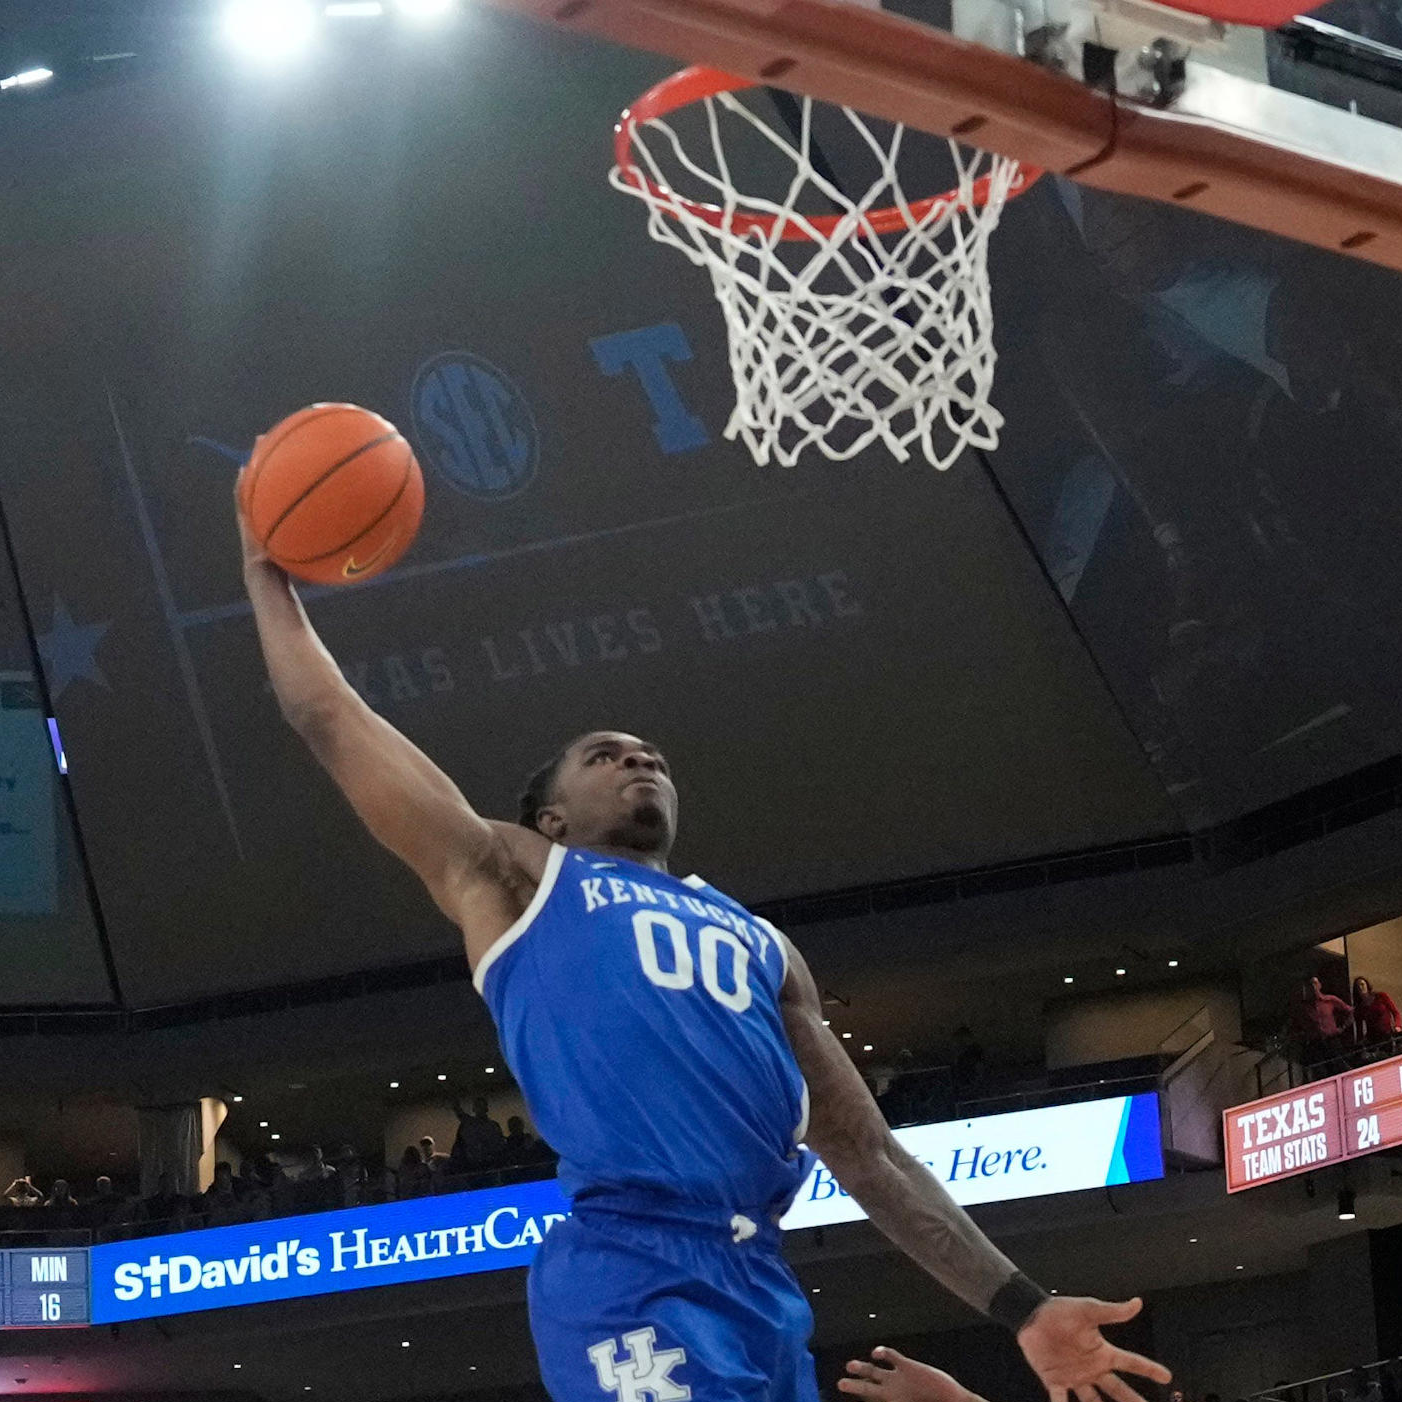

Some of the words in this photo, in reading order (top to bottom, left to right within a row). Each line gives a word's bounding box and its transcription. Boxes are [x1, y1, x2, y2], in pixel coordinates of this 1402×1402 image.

[588, 322, 711, 455] T
[481, 609, 663, 682] LIVES
[692, 570, 865, 644] HERE
[579, 878, 773, 963] KENTUCKY
[631, 909, 752, 1012] 00
[1354, 1078, 1373, 1107] FG
[1239, 1093, 1326, 1148] TEXAS
[1356, 1115, 1380, 1148] 24
[946, 1144, 1047, 1183] Here.
[1242, 1149, 1282, 1182] TEAM
[1284, 1134, 1327, 1172] STATS
[31, 1257, 68, 1282] MIN
[40, 1294, 61, 1320] 16
